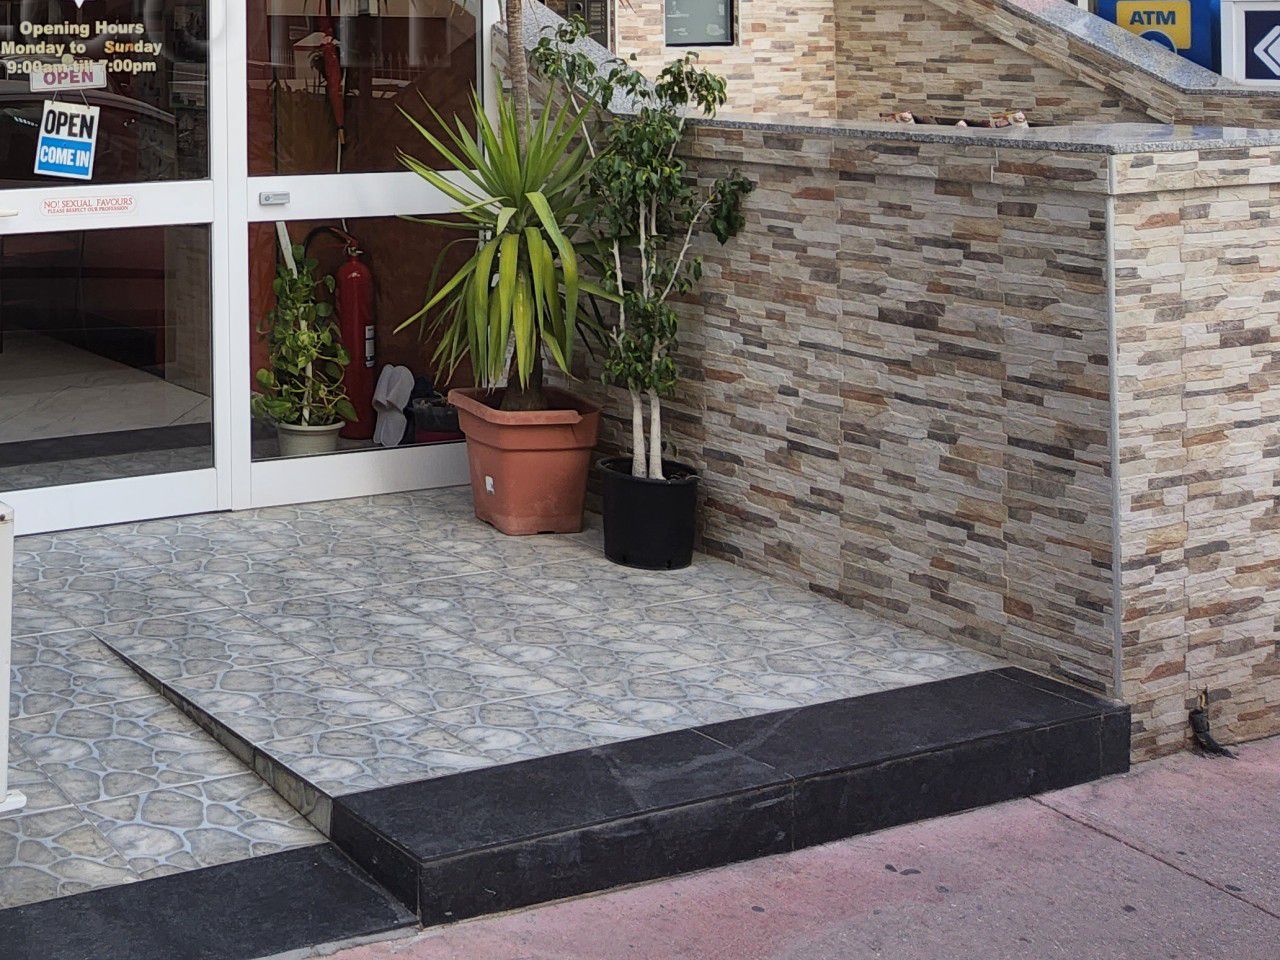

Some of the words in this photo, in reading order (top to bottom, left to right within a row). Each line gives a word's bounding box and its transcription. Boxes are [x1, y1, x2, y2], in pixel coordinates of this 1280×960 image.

[1129, 10, 1176, 25] ATM
[20, 21, 90, 38] Opening
[95, 21, 145, 34] Hours
[1, 41, 65, 57] Monday
[70, 41, 86, 54] to
[104, 40, 162, 56] Sunday
[43, 71, 94, 85] OPEN
[44, 109, 95, 139] OPEN
[40, 145, 75, 166] COME
[75, 150, 90, 168] IN
[44, 200, 60, 209] NO!
[62, 199, 92, 208] SEXUAL
[96, 197, 133, 207] FAVOURS
